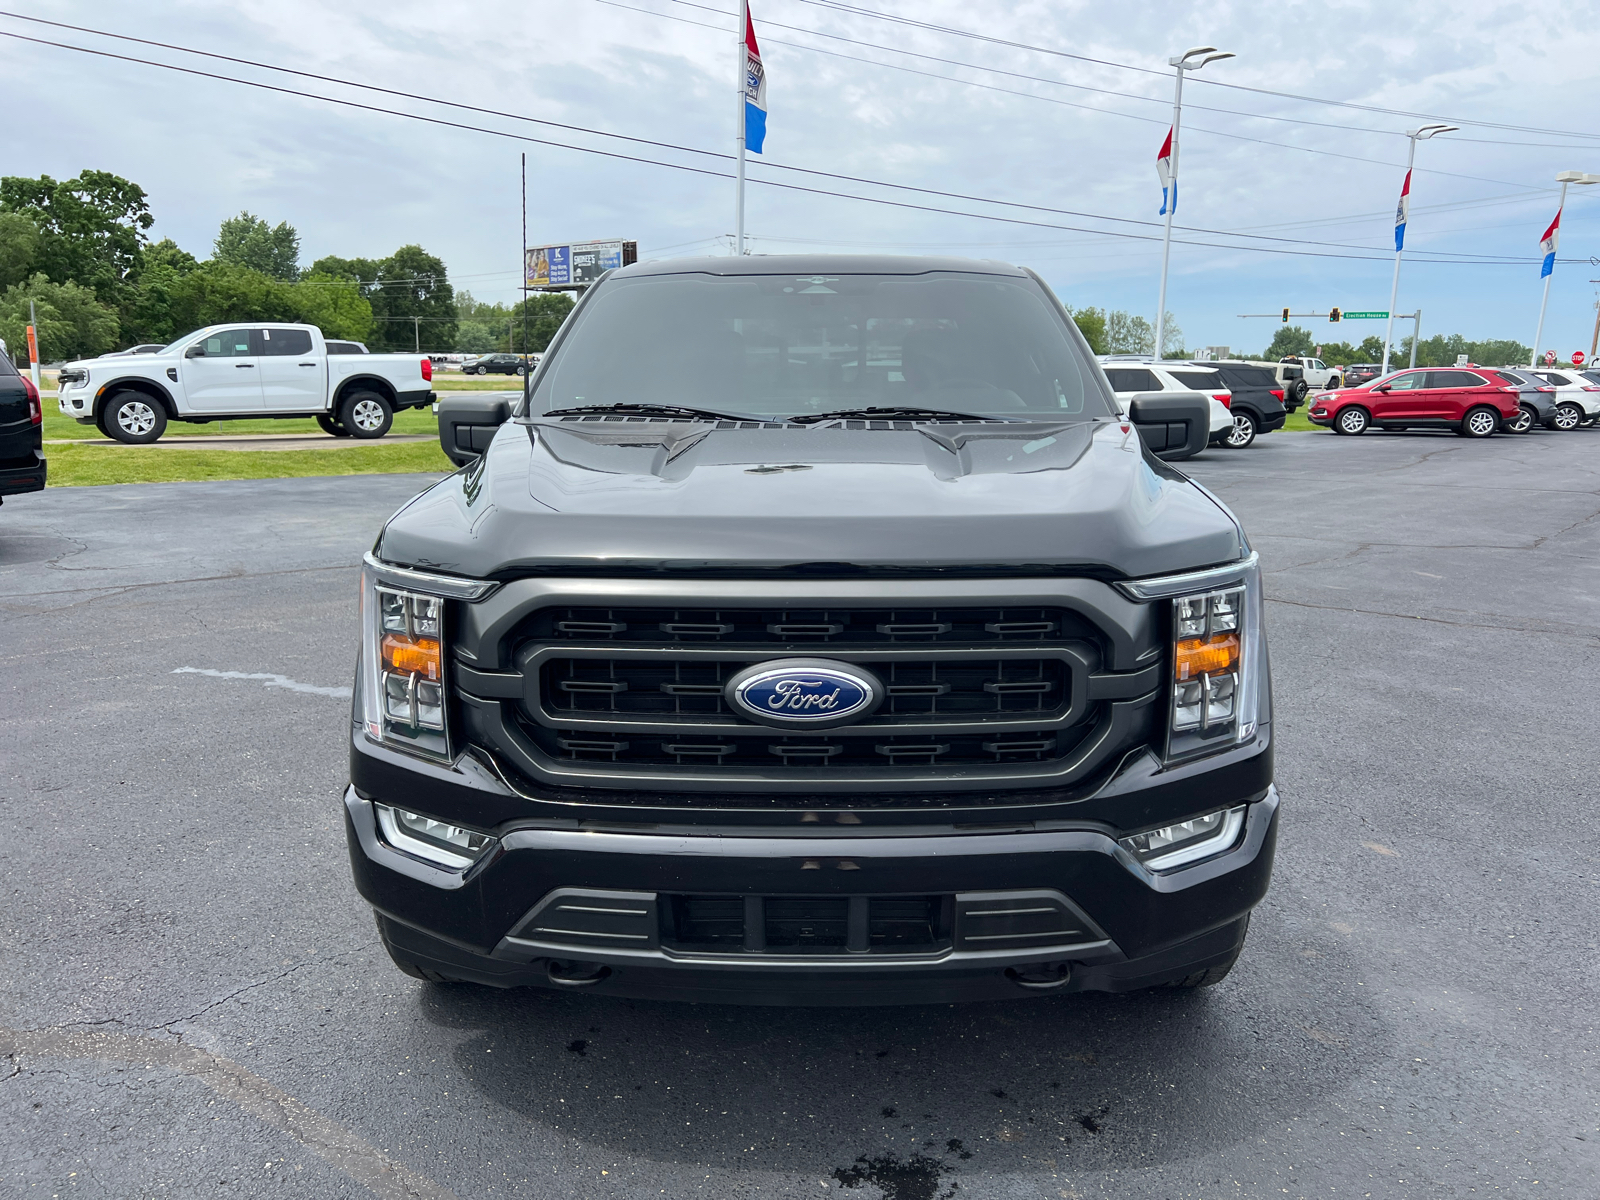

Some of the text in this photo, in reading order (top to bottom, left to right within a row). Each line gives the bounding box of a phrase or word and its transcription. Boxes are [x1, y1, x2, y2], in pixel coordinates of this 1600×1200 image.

[747, 59, 763, 76] UILT
[555, 248, 561, 258] K
[768, 680, 840, 709] Ford
